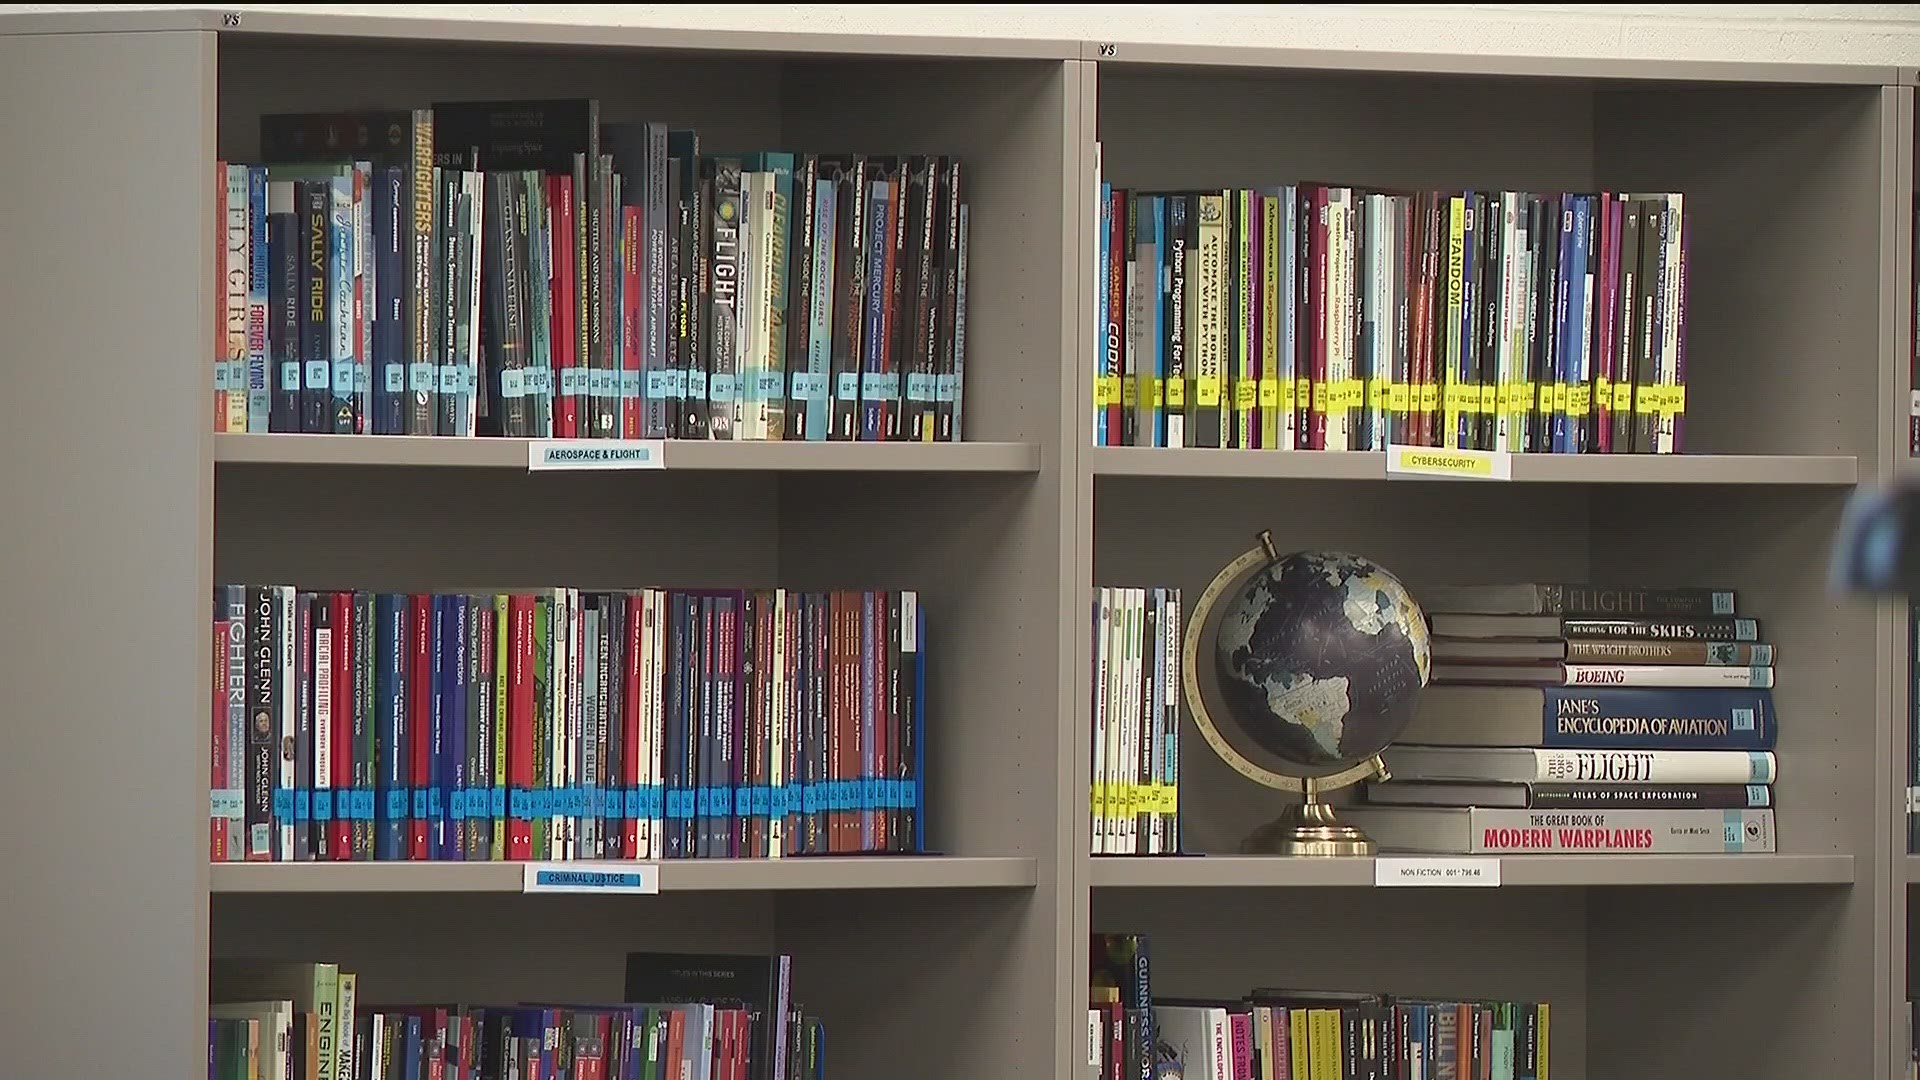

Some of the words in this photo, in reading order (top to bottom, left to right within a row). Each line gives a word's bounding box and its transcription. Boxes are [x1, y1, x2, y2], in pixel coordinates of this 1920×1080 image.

[1100, 44, 1116, 56] VS
[415, 122, 432, 233] WARFIGHTERS
[228, 207, 246, 259] FLY
[311, 214, 324, 271] SALLY
[592, 208, 600, 252] SHUTTLES
[874, 204, 885, 255] PROJECT
[670, 237, 679, 270] AREA
[714, 228, 738, 308] FLIGHT
[1172, 240, 1184, 273] Python
[1202, 244, 1210, 282] STUFF
[1334, 248, 1342, 282] Projects
[286, 254, 296, 292] SALLY
[592, 274, 600, 300] SPACE
[819, 258, 827, 298] ROCKET
[872, 258, 882, 313] MERCURY
[1268, 271, 1275, 283] in
[1450, 237, 1462, 305] FANDOM
[228, 268, 247, 363] GIRLS
[286, 297, 296, 328] RIDE
[310, 277, 324, 323] RIDE
[670, 290, 678, 329] BLACK
[1171, 277, 1183, 342] Programming
[250, 304, 265, 351] FOREVER
[338, 280, 352, 357] Cochran
[592, 302, 600, 344] MISSIONS
[716, 316, 724, 342] HISTORY
[1210, 306, 1218, 331] THE
[1332, 296, 1341, 346] Raspberry
[1486, 302, 1496, 348] Cyberbullying
[669, 334, 677, 363] JETS
[723, 331, 731, 368] COMPLETE
[1173, 344, 1183, 361] For
[1334, 348, 1341, 357] Pi
[251, 354, 265, 390] FLYING
[712, 416, 729, 431] DK
[548, 450, 601, 461] AEROSPACE
[602, 450, 610, 460] &
[610, 450, 641, 460] FLIGHT
[1411, 456, 1476, 469] CYBERSECURITY
[260, 594, 271, 641] JOHN
[1570, 590, 1650, 612] FLIGHT
[457, 606, 465, 645] Undercover
[1608, 626, 1629, 635] FOR
[1650, 624, 1696, 638] SKIES
[229, 603, 246, 708] FIGHTER!
[286, 644, 294, 667] Courts
[600, 632, 608, 660] TEEN
[1573, 644, 1591, 656] THE
[1592, 644, 1627, 657] WRIGHT
[1628, 644, 1672, 657] BROTHERS
[260, 646, 271, 704] GLENN
[456, 646, 465, 686] Operations
[1576, 670, 1625, 684] BOEING
[318, 668, 329, 715] PROFILING
[598, 662, 608, 744] INCARCERATION
[1557, 699, 1600, 717] JANE'S
[586, 694, 595, 737] WOMEN
[1558, 718, 1649, 735] ENCYCLOPEDIA
[1650, 718, 1669, 735] OF
[1668, 718, 1729, 737] AVIATION
[261, 746, 269, 776] JOHN
[586, 740, 595, 751] IN
[586, 754, 595, 782] BLUE
[1576, 752, 1654, 782] FLIGHT
[1572, 791, 1597, 800] ATLAS
[1600, 791, 1612, 800] OF
[1614, 791, 1640, 800] SPACE
[1642, 791, 1698, 800] EXPLORATION
[1530, 815, 1545, 827] THE
[1546, 815, 1570, 827] GREAT
[1572, 815, 1593, 826] BOOK
[1594, 815, 1605, 826] OF
[1484, 828, 1552, 849] MODERN
[1559, 828, 1654, 849] WARPLANES
[548, 873, 588, 884] CRIMINAL
[590, 874, 625, 884] JUSTICE
[1400, 868, 1415, 877] NON
[1416, 868, 1442, 877] FICTION
[1138, 956, 1150, 1037] GUINNESS
[1235, 1020, 1246, 1053] NOTES
[1438, 1012, 1457, 1057] BILL
